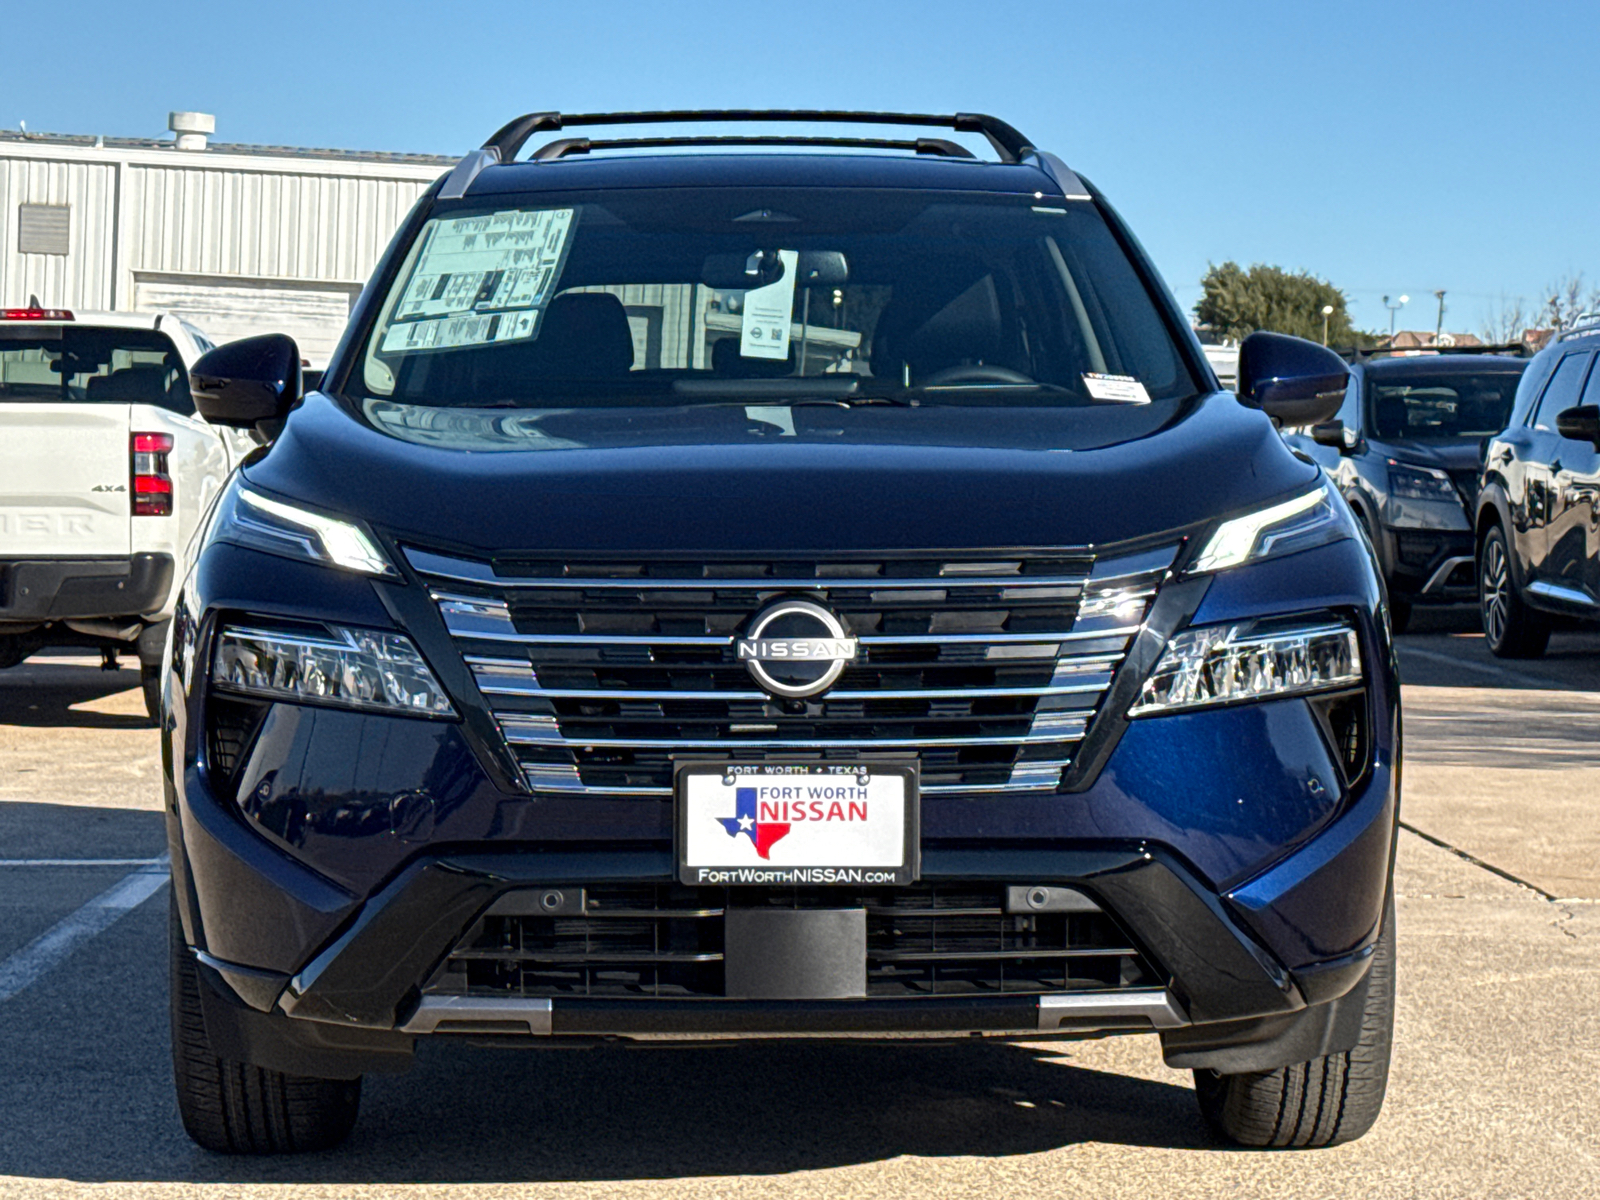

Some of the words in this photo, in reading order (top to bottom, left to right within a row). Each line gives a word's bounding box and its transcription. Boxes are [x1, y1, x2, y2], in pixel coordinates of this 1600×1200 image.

[739, 642, 851, 657] NISSAN
[726, 766, 759, 775] FORT
[764, 766, 809, 775] WORTH
[827, 766, 868, 775] TEXAS
[759, 786, 802, 799] FORT
[807, 786, 868, 799] WORTH
[760, 801, 867, 821] NISSAN
